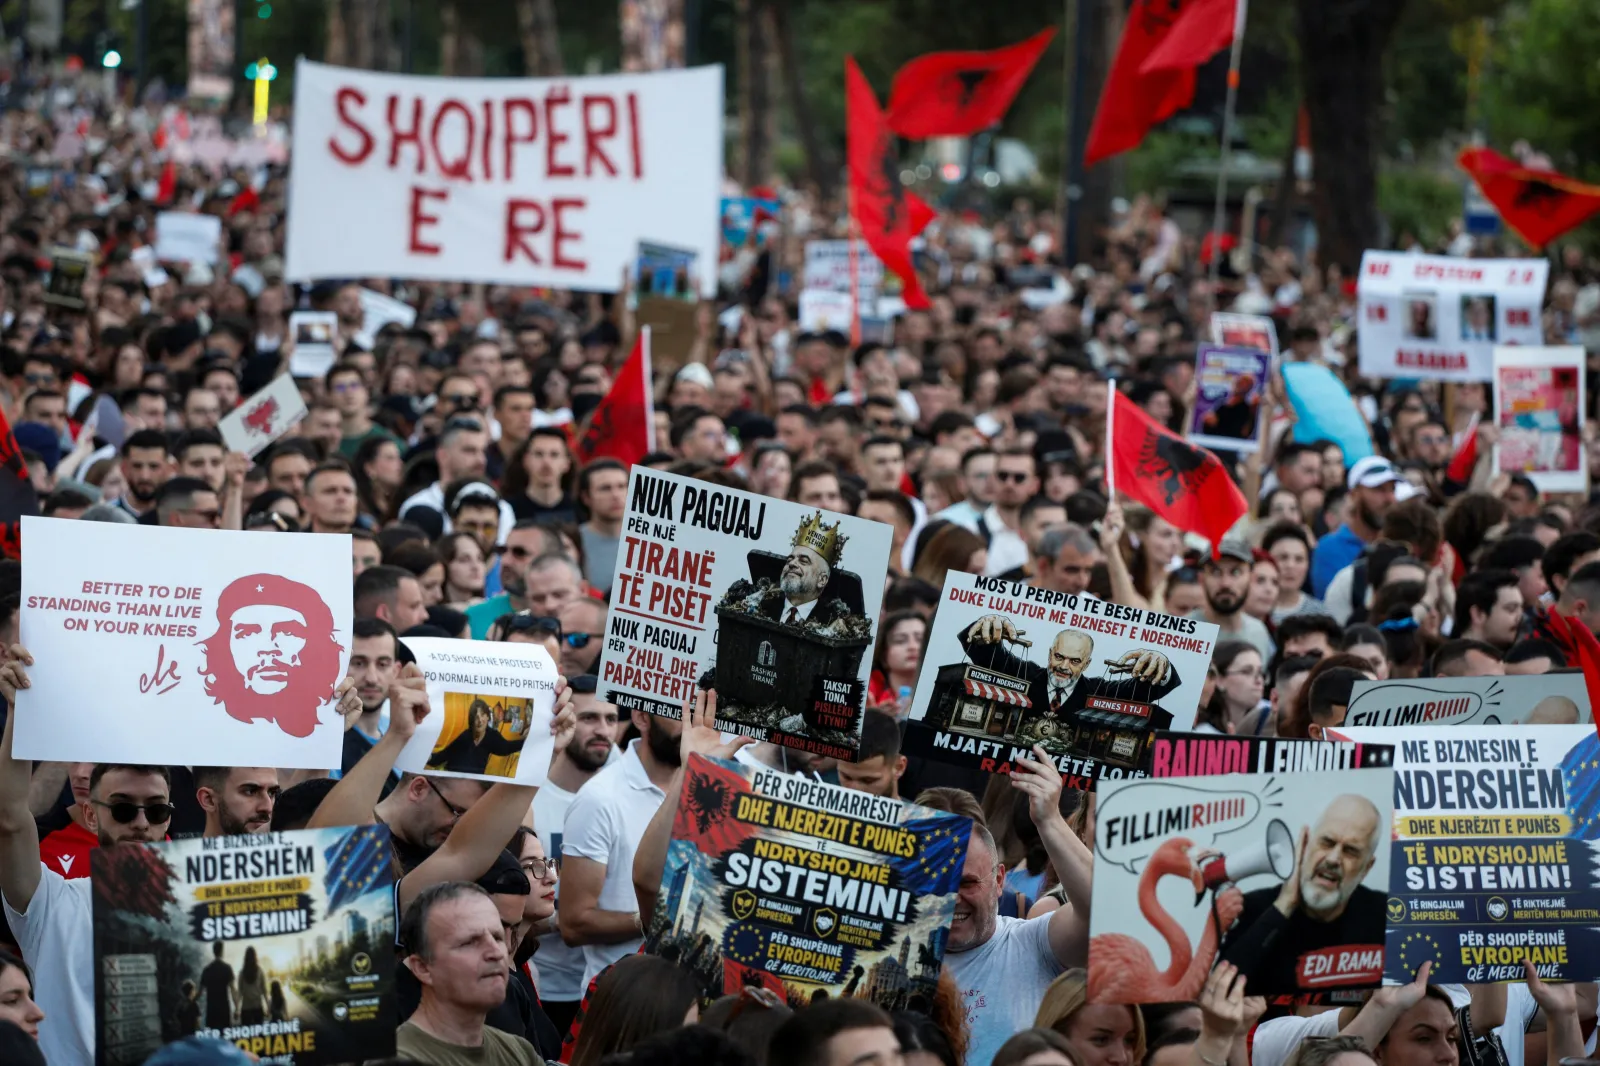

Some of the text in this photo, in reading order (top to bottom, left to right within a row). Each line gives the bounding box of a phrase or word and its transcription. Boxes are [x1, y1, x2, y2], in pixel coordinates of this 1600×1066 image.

[328, 83, 643, 183] SHQIPËRI
[409, 184, 588, 271] E RE
[631, 473, 766, 540] NUK PAGUAJ
[627, 516, 677, 542] PËR NJË
[625, 535, 716, 588] TIRANË
[82, 581, 202, 600] BETTER TO DIE
[618, 572, 645, 608] TË
[26, 596, 202, 619] STANDING THAN LIVE
[949, 587, 985, 607] DUKE
[987, 595, 1046, 620] LUAJTUR
[1048, 609, 1067, 625] ME
[1069, 614, 1127, 637] BIZNESET
[1128, 626, 1137, 639] E
[974, 575, 1198, 634] MOS U PERPIQ TE BESH BIZNES
[63, 618, 197, 638] ON YOUR KNEES
[610, 616, 697, 655] NUK PAGUAJ
[437, 653, 451, 662] DO
[451, 654, 485, 665] SHKOSH
[486, 657, 499, 666] NE
[500, 658, 543, 670] PROTESTE?
[608, 637, 698, 680] PËR ZHUL DHE
[424, 671, 554, 690] PO NORMALE UN ATE PO PRITSHA
[823, 679, 852, 694] TAKSAT
[970, 670, 992, 682] BIZNES
[824, 690, 848, 706] TONA,
[1093, 700, 1121, 711] BIZNES
[1129, 705, 1143, 714] TIJ
[616, 693, 642, 709] MJAFT
[643, 701, 655, 713] ME
[738, 721, 769, 742] TIRANË,
[770, 732, 781, 744] JO
[784, 735, 805, 751] KOSH
[807, 742, 852, 760] PLEHRASH!
[817, 714, 848, 729] I TYNI!
[933, 731, 1004, 759] MJAFT
[1053, 754, 1095, 778] KËTË
[1401, 739, 1538, 763] ME BIZNESIN E
[751, 769, 902, 824] PËR SIPËRMARRËSIT
[1394, 762, 1566, 810] NDERSHËM
[736, 795, 917, 858] DHE NJERËZIT E PUNËS
[1409, 815, 1561, 835] DHE NJERËZIT E PUNËS
[202, 837, 220, 850] ME
[816, 840, 827, 851] TË
[1403, 840, 1568, 865] TË NDRYSHOJMË
[186, 841, 315, 884] NDERSHËM
[753, 840, 891, 884] NDRYSHOJMË
[724, 852, 911, 922] SISTEMIN!
[1405, 865, 1572, 890] SISTEMIN!
[205, 887, 222, 898] DHE
[1409, 898, 1465, 909] TË RINGJALLIM
[1511, 897, 1566, 908] TË RIKTHEJMË
[758, 898, 803, 915] TË RINGJALLIM
[1410, 910, 1460, 921] SHPRESËN.
[1513, 909, 1545, 919] MERITËN
[1545, 910, 1561, 919] DHE
[202, 909, 307, 940] SISTEMIN!
[841, 914, 884, 931] TË RIKTHEJMË
[770, 931, 844, 956] PËR SHQIPËRINË
[869, 929, 882, 941] DHE
[1459, 930, 1566, 946] PËR SHQIPËRINË
[766, 943, 843, 972] EVROPIANE
[1303, 949, 1382, 977] EDI RAMA
[1460, 946, 1568, 965] EVROPIANE
[764, 959, 836, 984] QË MERITOJMË.
[1467, 963, 1563, 981] QË MERITJMË.
